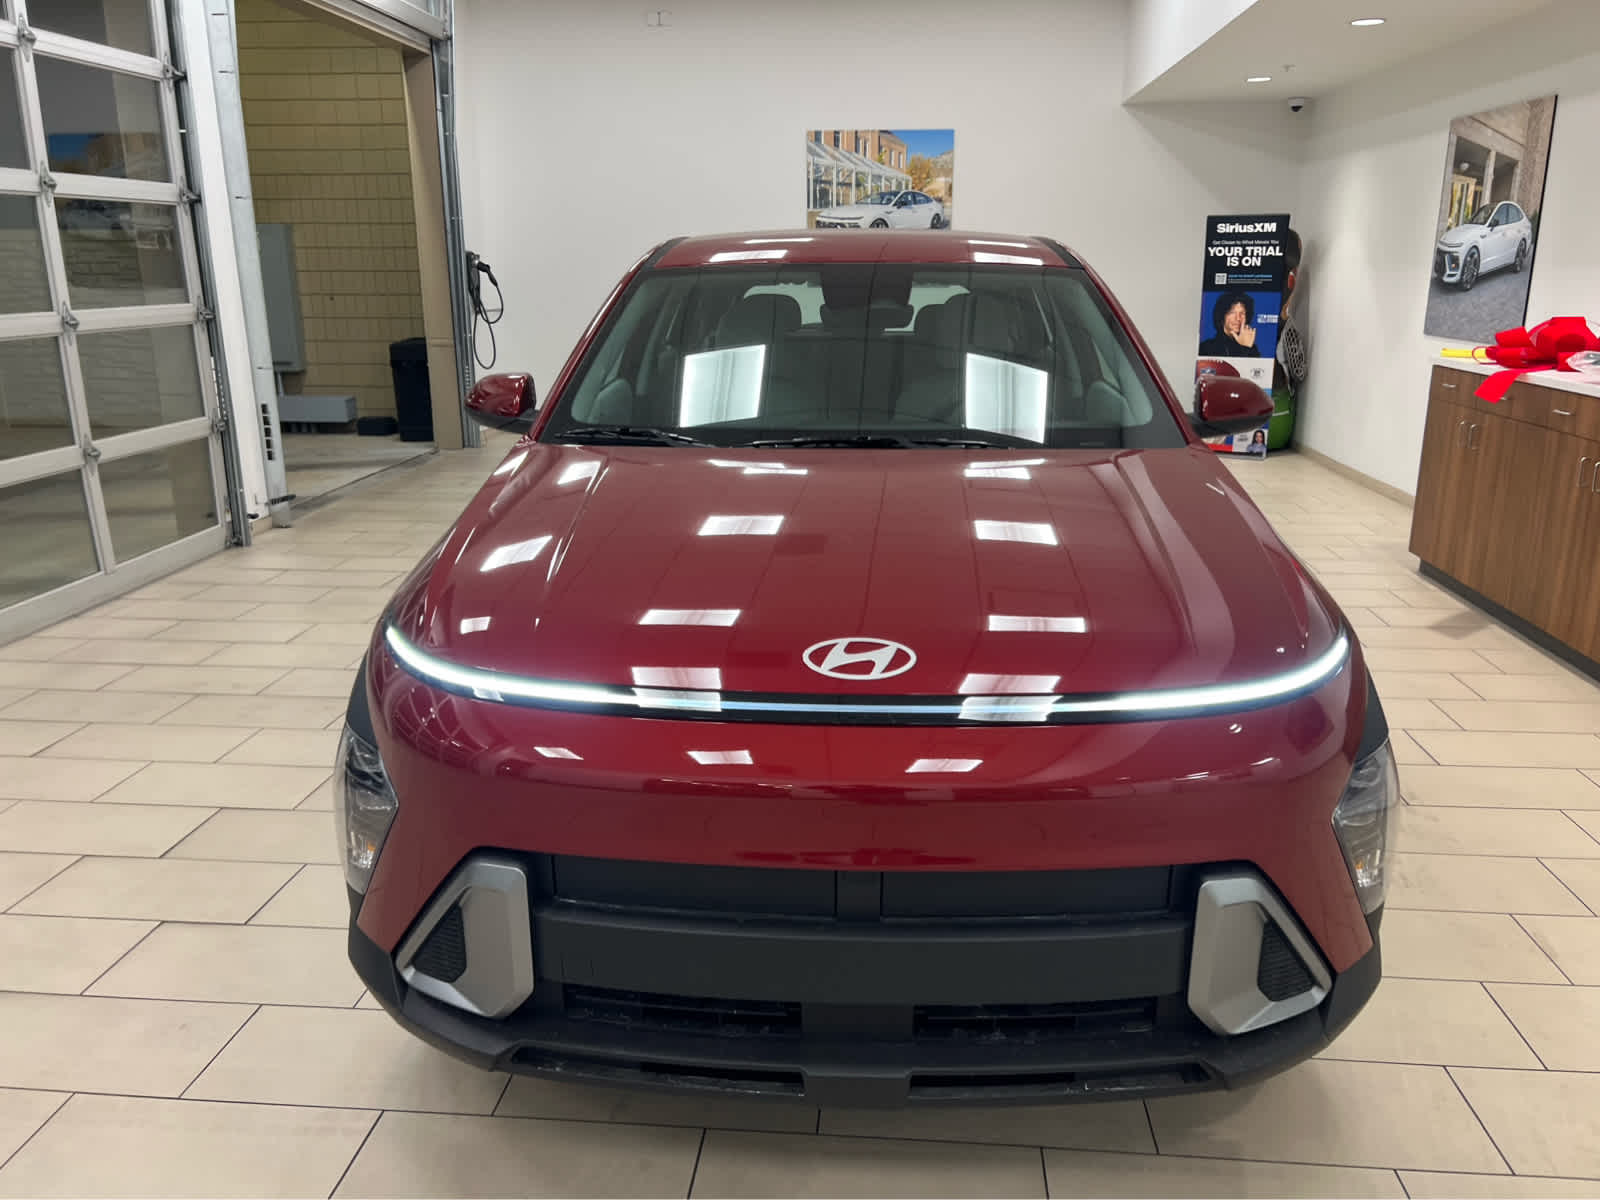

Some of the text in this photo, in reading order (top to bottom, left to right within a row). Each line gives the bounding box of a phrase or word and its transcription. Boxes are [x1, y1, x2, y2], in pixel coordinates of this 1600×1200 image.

[1216, 222, 1277, 233] SiriusXM
[1208, 246, 1283, 257] YOUR TRIAL
[1226, 256, 1262, 267] IS ON
